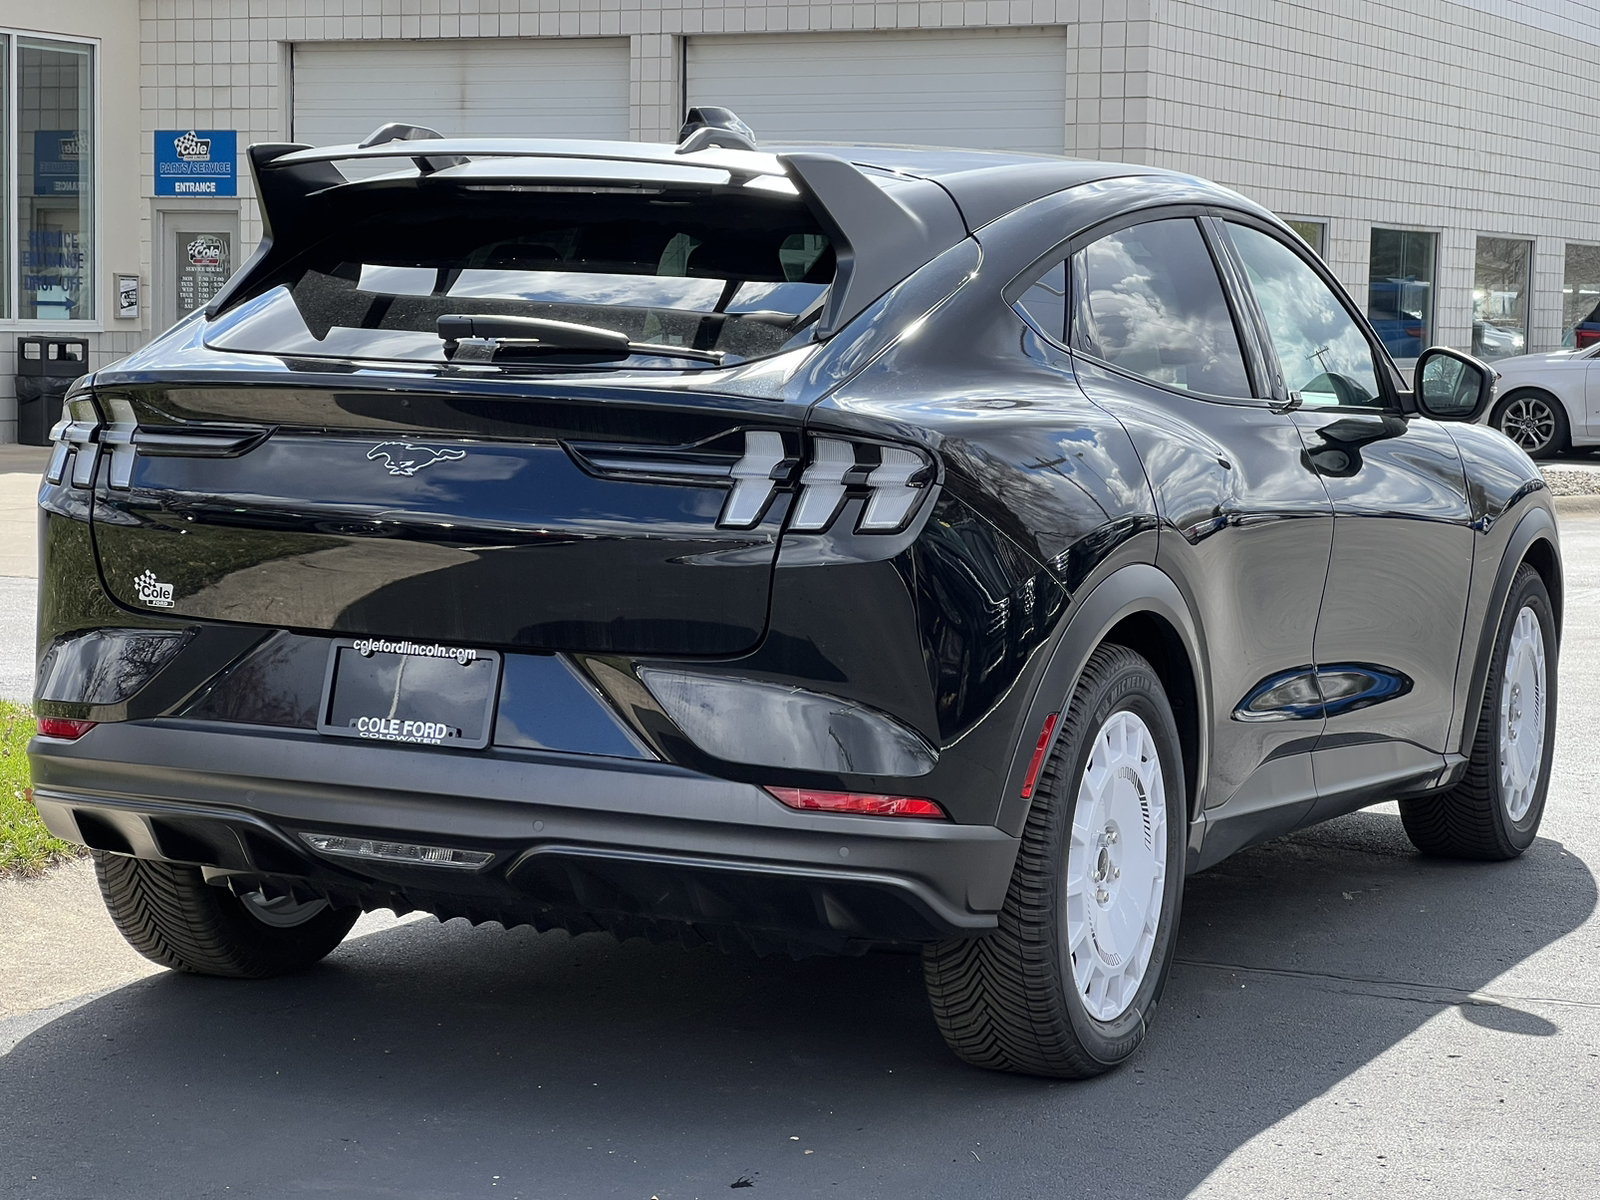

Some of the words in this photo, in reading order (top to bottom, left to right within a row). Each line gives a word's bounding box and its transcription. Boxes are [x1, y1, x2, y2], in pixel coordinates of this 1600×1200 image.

[181, 143, 207, 154] Cole
[160, 162, 231, 174] PARTS/SERVICE
[175, 182, 216, 192] ENTRANCE
[195, 246, 220, 258] Cole
[142, 585, 170, 599] Cole
[353, 638, 477, 660] colefordlincoln.com
[357, 716, 400, 735] COLE
[402, 720, 447, 739] FORD
[359, 732, 441, 745] COLDWATER
